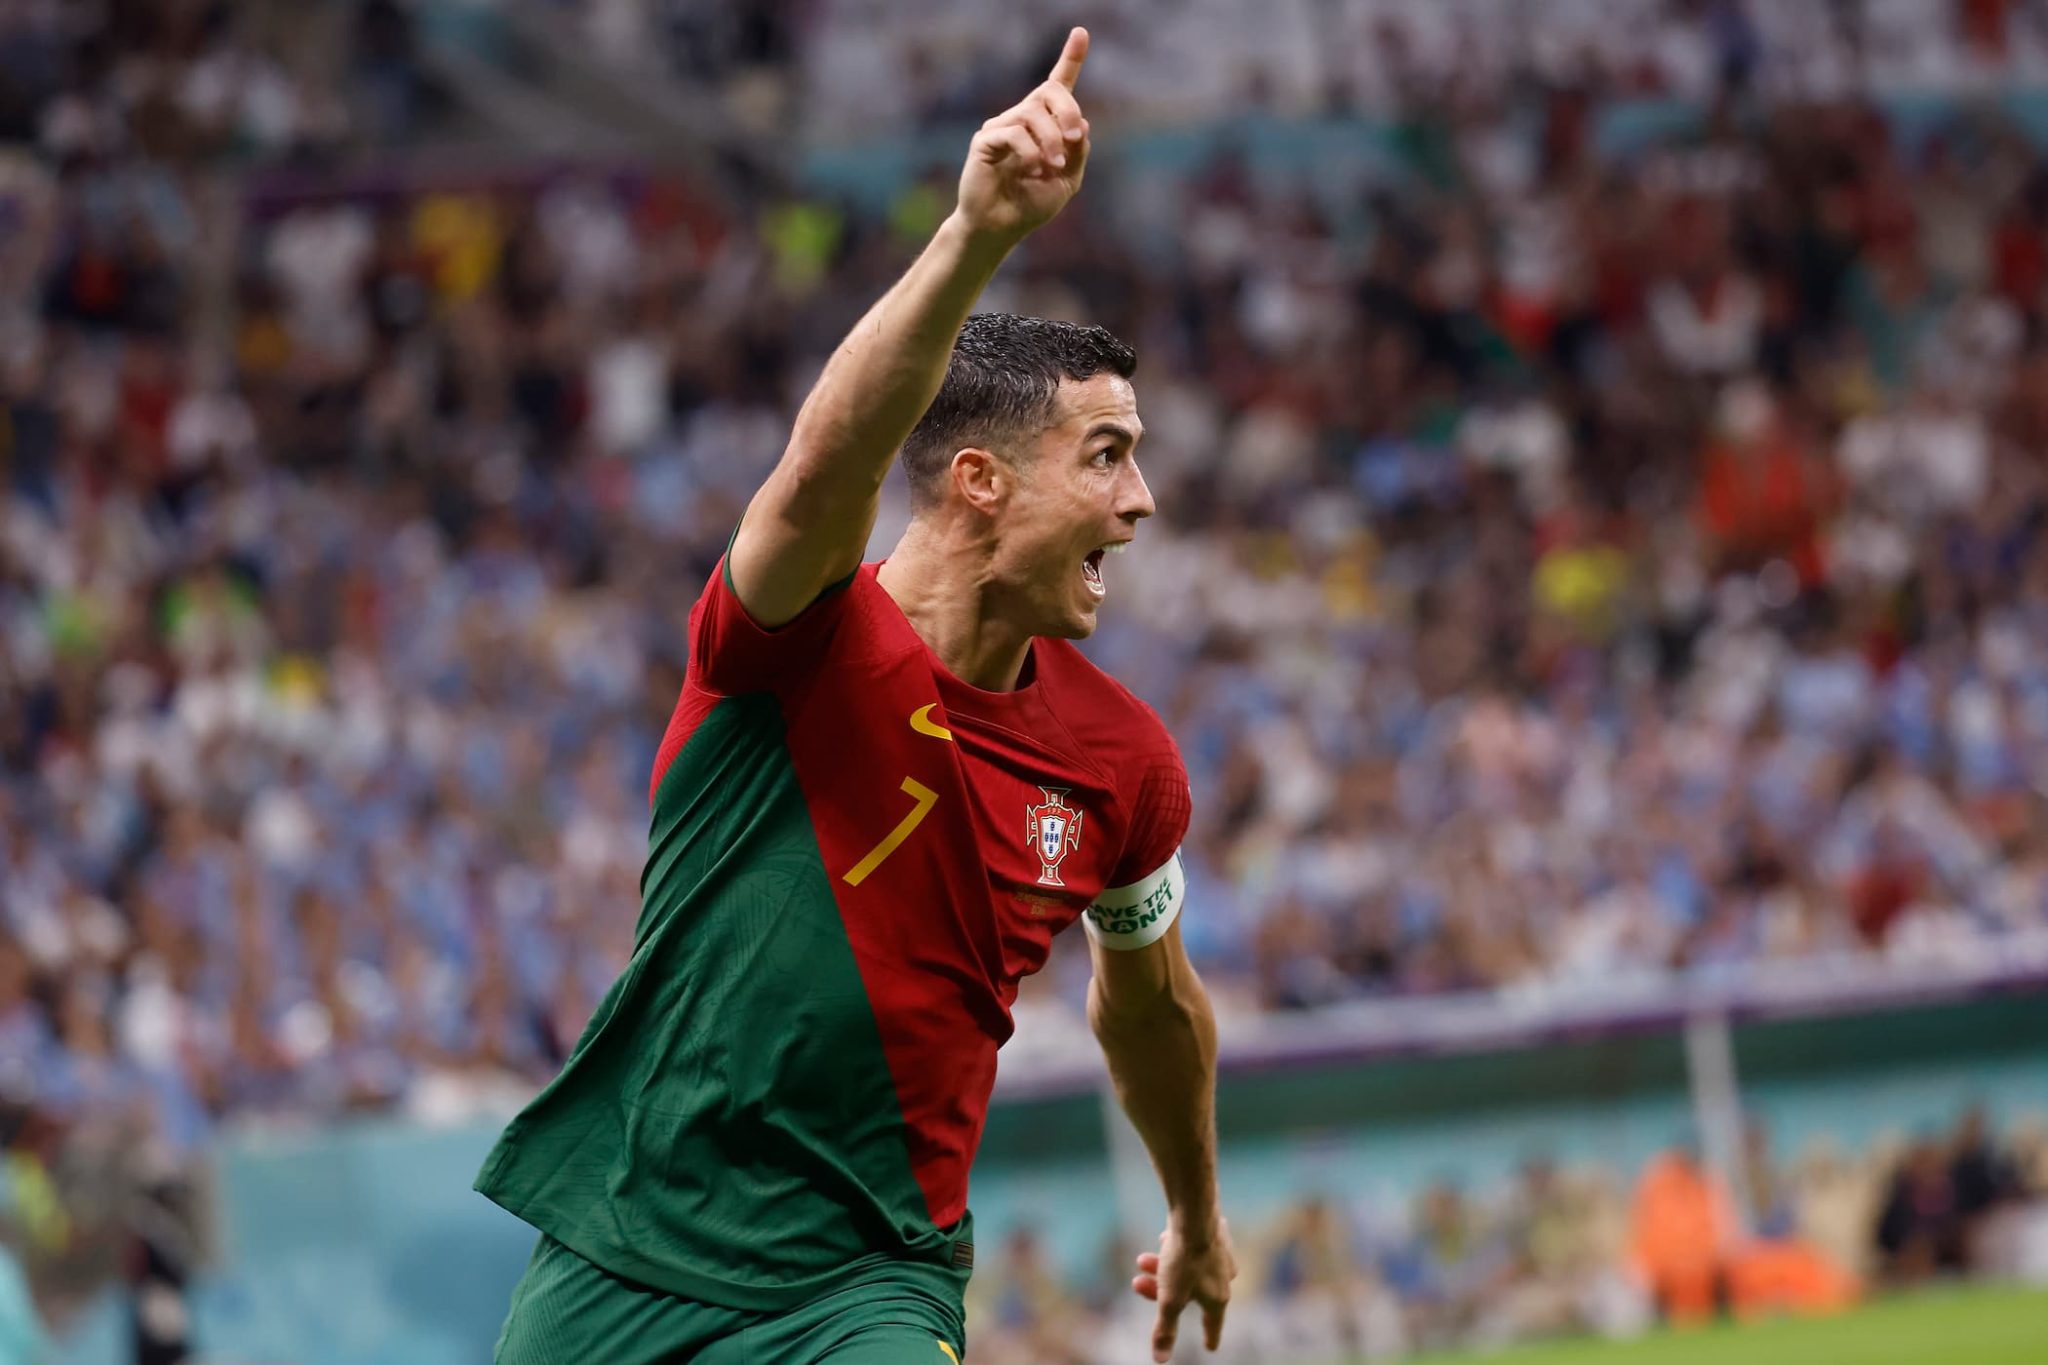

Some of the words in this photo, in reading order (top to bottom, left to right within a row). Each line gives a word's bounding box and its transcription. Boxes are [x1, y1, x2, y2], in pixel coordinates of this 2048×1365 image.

[842, 775, 939, 887] 7
[1088, 904, 1139, 918] AVE
[1143, 876, 1169, 908] THE
